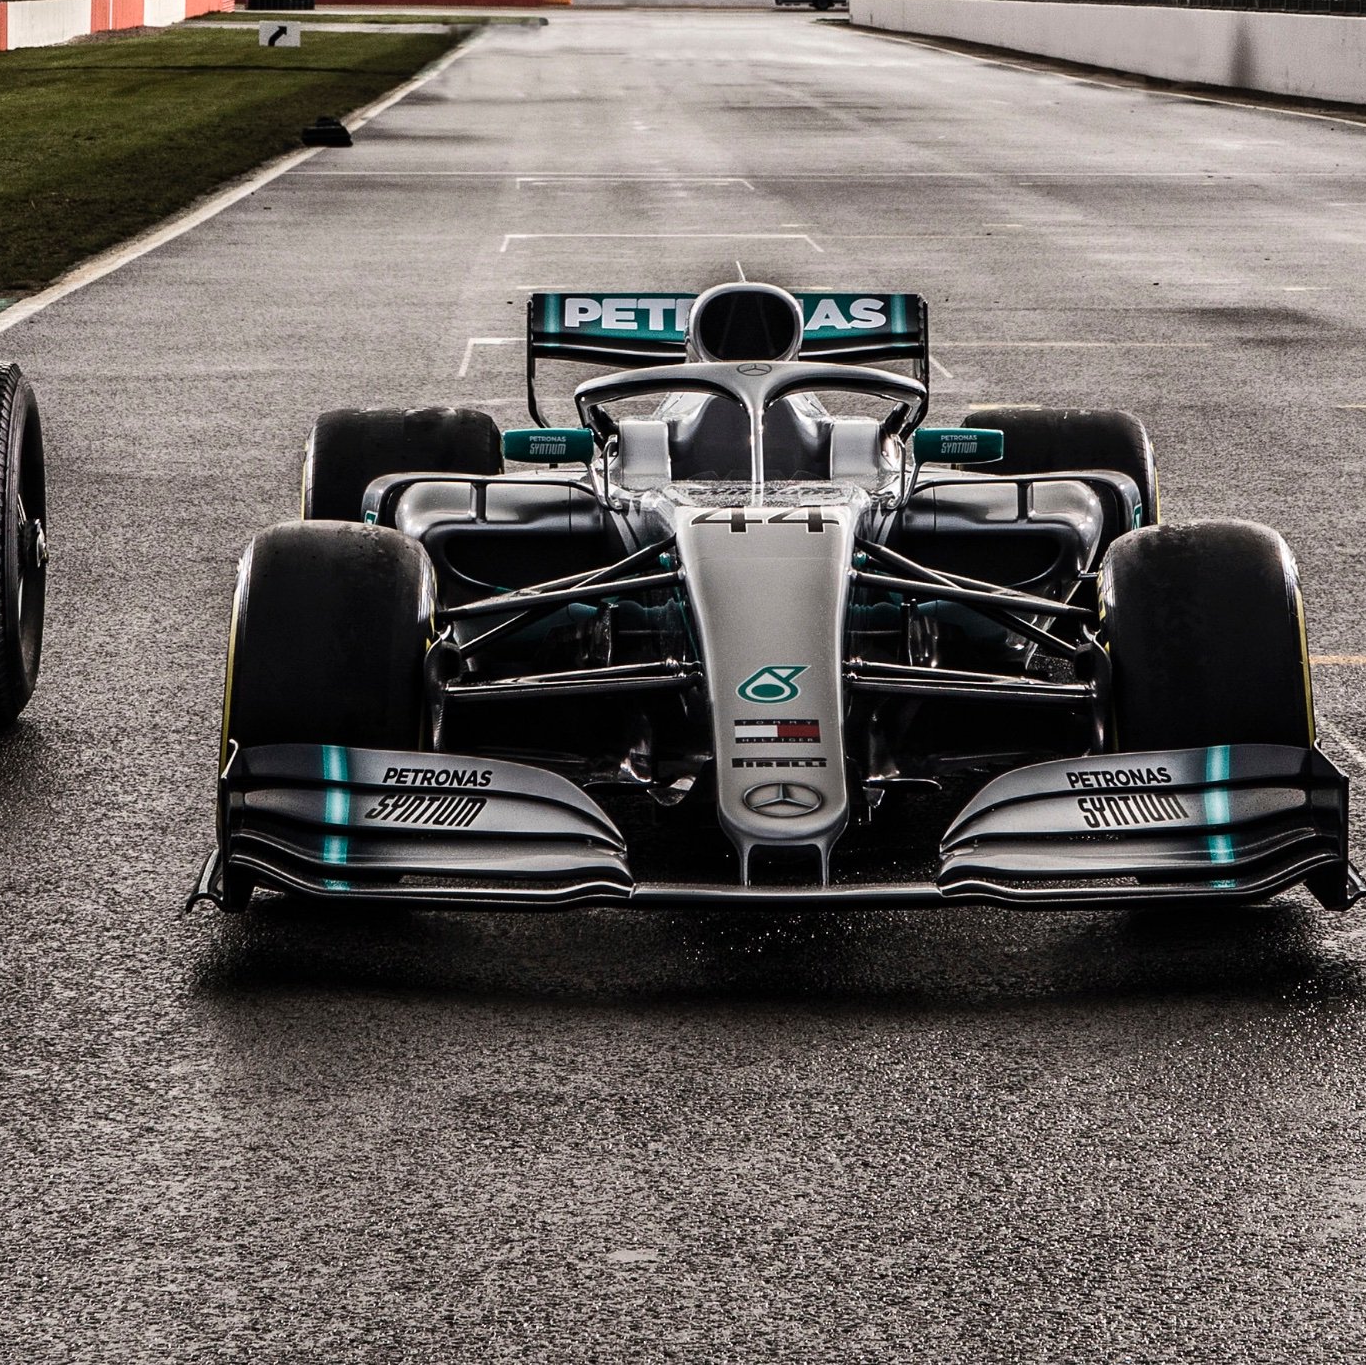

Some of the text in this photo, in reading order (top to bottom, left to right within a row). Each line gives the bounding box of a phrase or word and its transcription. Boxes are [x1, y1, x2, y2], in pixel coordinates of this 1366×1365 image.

[564, 297, 887, 332] PETAS
[529, 443, 567, 455] SYNTIUM
[940, 442, 978, 454] SYNTIUM
[691, 505, 840, 534] 44
[731, 757, 828, 768] PIRELLI
[382, 767, 493, 787] PETRONAS
[1066, 767, 1172, 788] PETRONAS
[364, 794, 487, 827] SYNTIUM
[1077, 793, 1190, 829] SYNTIUM
